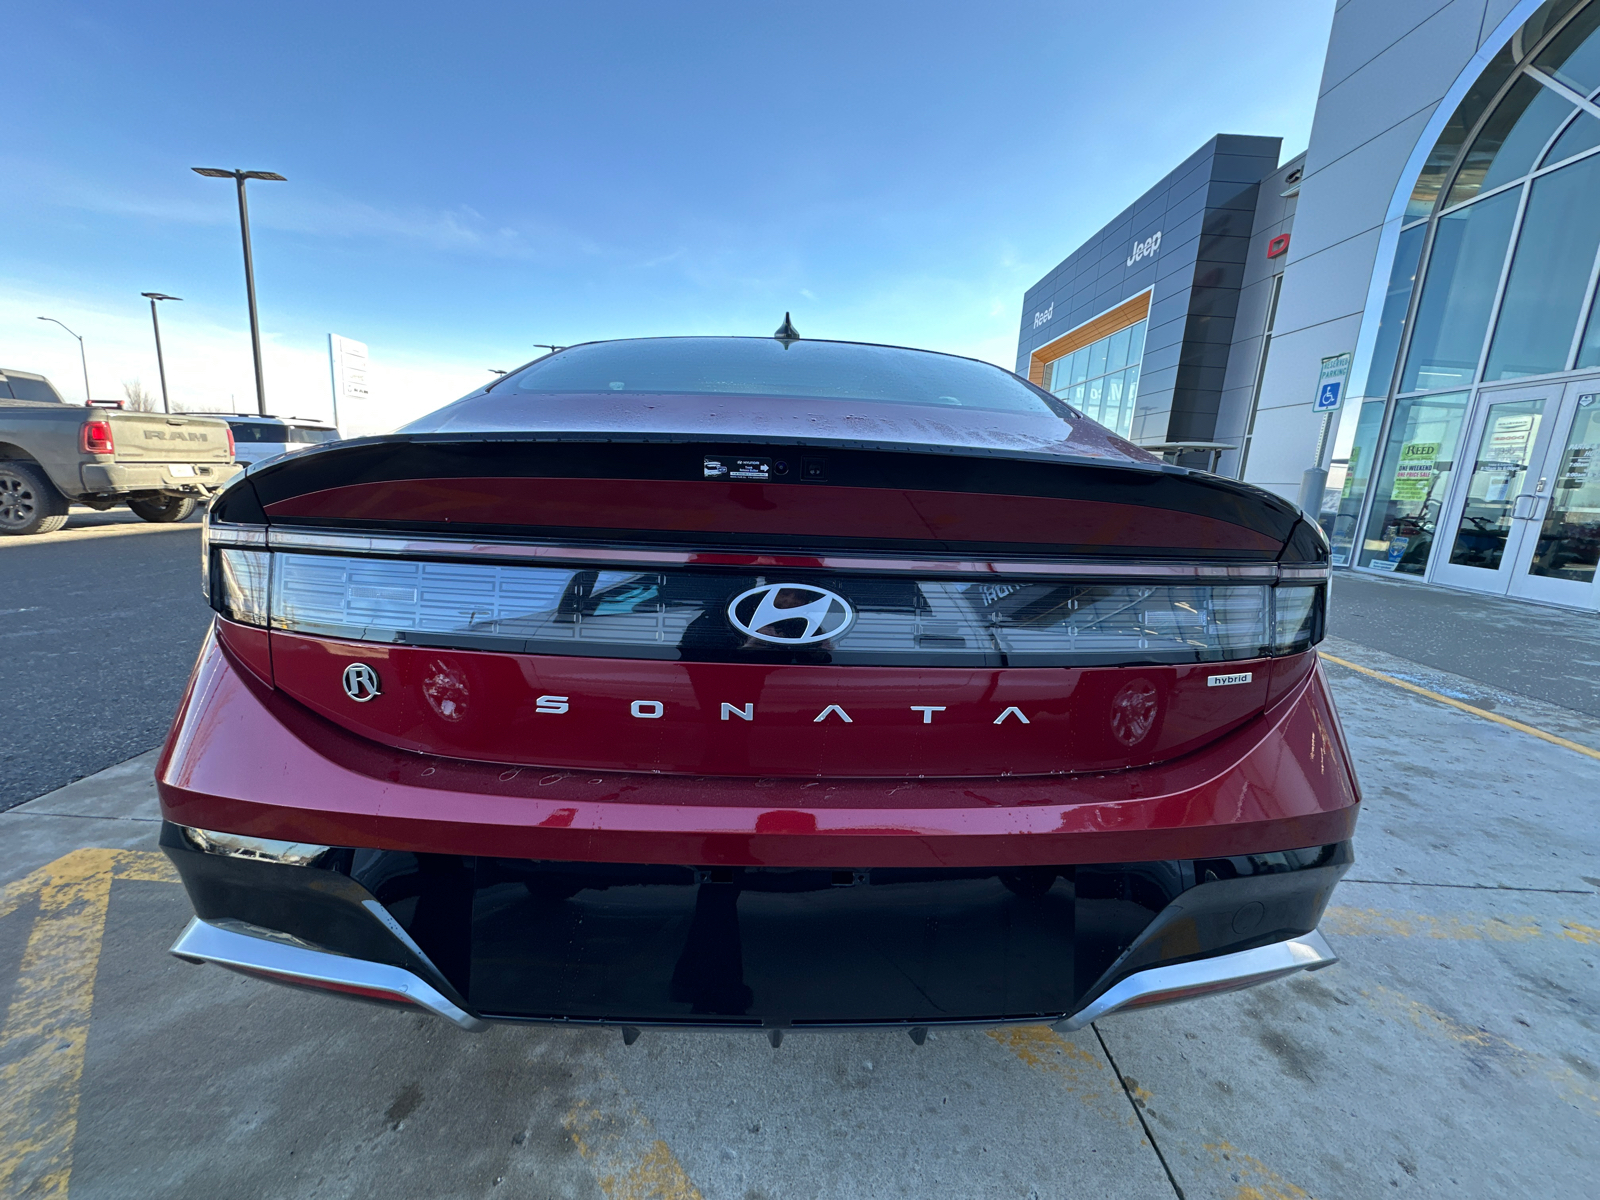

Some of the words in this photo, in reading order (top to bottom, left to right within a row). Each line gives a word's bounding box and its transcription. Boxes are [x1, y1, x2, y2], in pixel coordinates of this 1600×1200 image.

[1126, 231, 1162, 267] Jeep
[1033, 301, 1054, 329] Reed
[1323, 357, 1349, 369] RESERVED
[1321, 367, 1347, 379] PARKING
[144, 430, 208, 442] RAM
[1405, 445, 1435, 458] REED
[1214, 674, 1248, 685] hybrid
[536, 695, 1030, 725] SONATA
